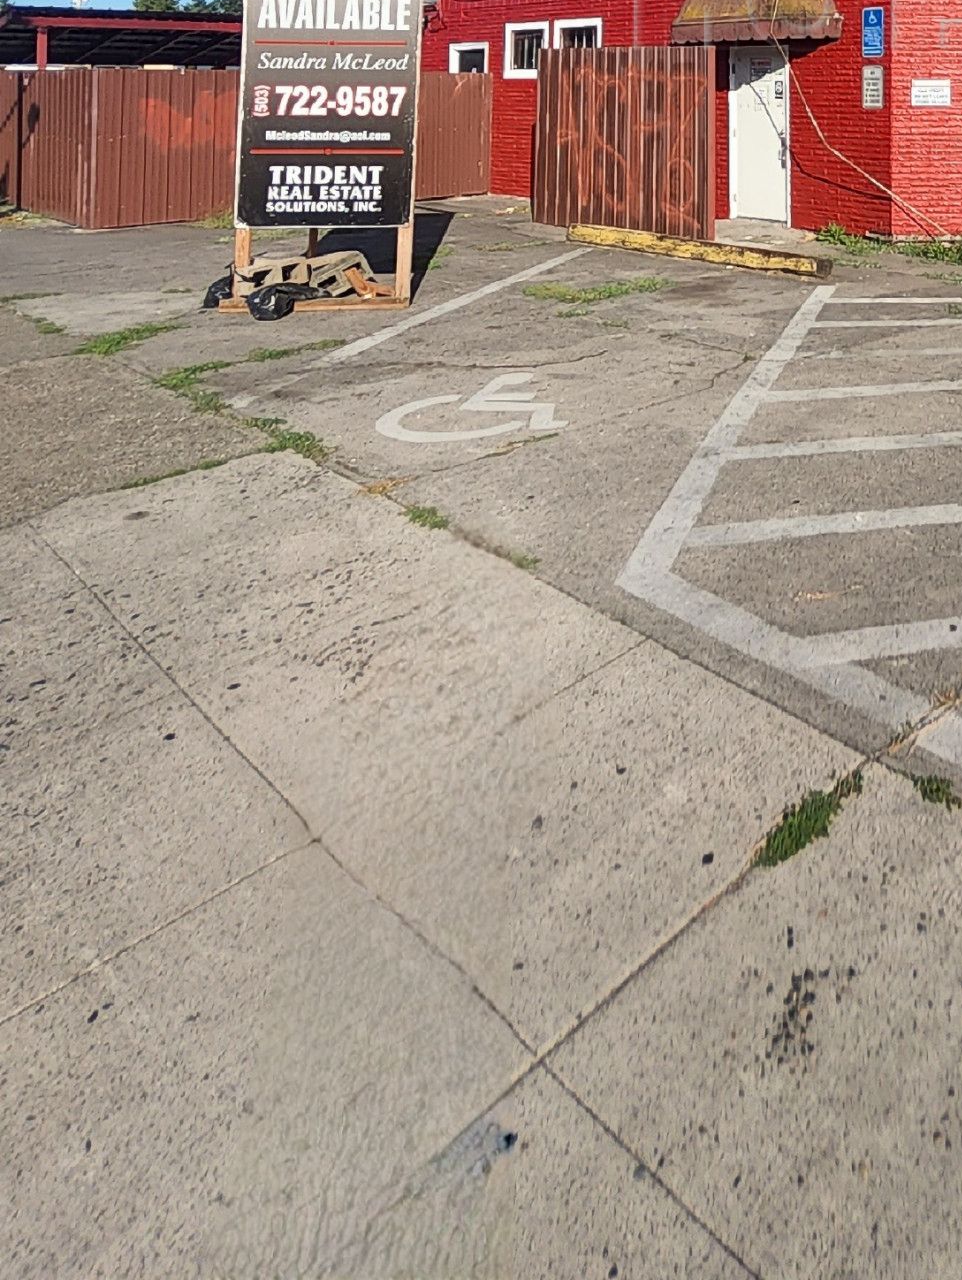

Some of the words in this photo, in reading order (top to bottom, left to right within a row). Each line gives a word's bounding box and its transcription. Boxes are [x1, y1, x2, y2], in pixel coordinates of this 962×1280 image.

[257, 52, 326, 70] Sandra
[331, 53, 409, 71] McLeod
[251, 84, 272, 117] (503)
[275, 85, 407, 117] 722-9587
[268, 165, 384, 185] TRIDENT
[267, 185, 313, 201] REAL
[319, 185, 383, 201] ESTATE
[265, 201, 350, 213] SOLUTIONS,
[353, 201, 382, 212] INC.
